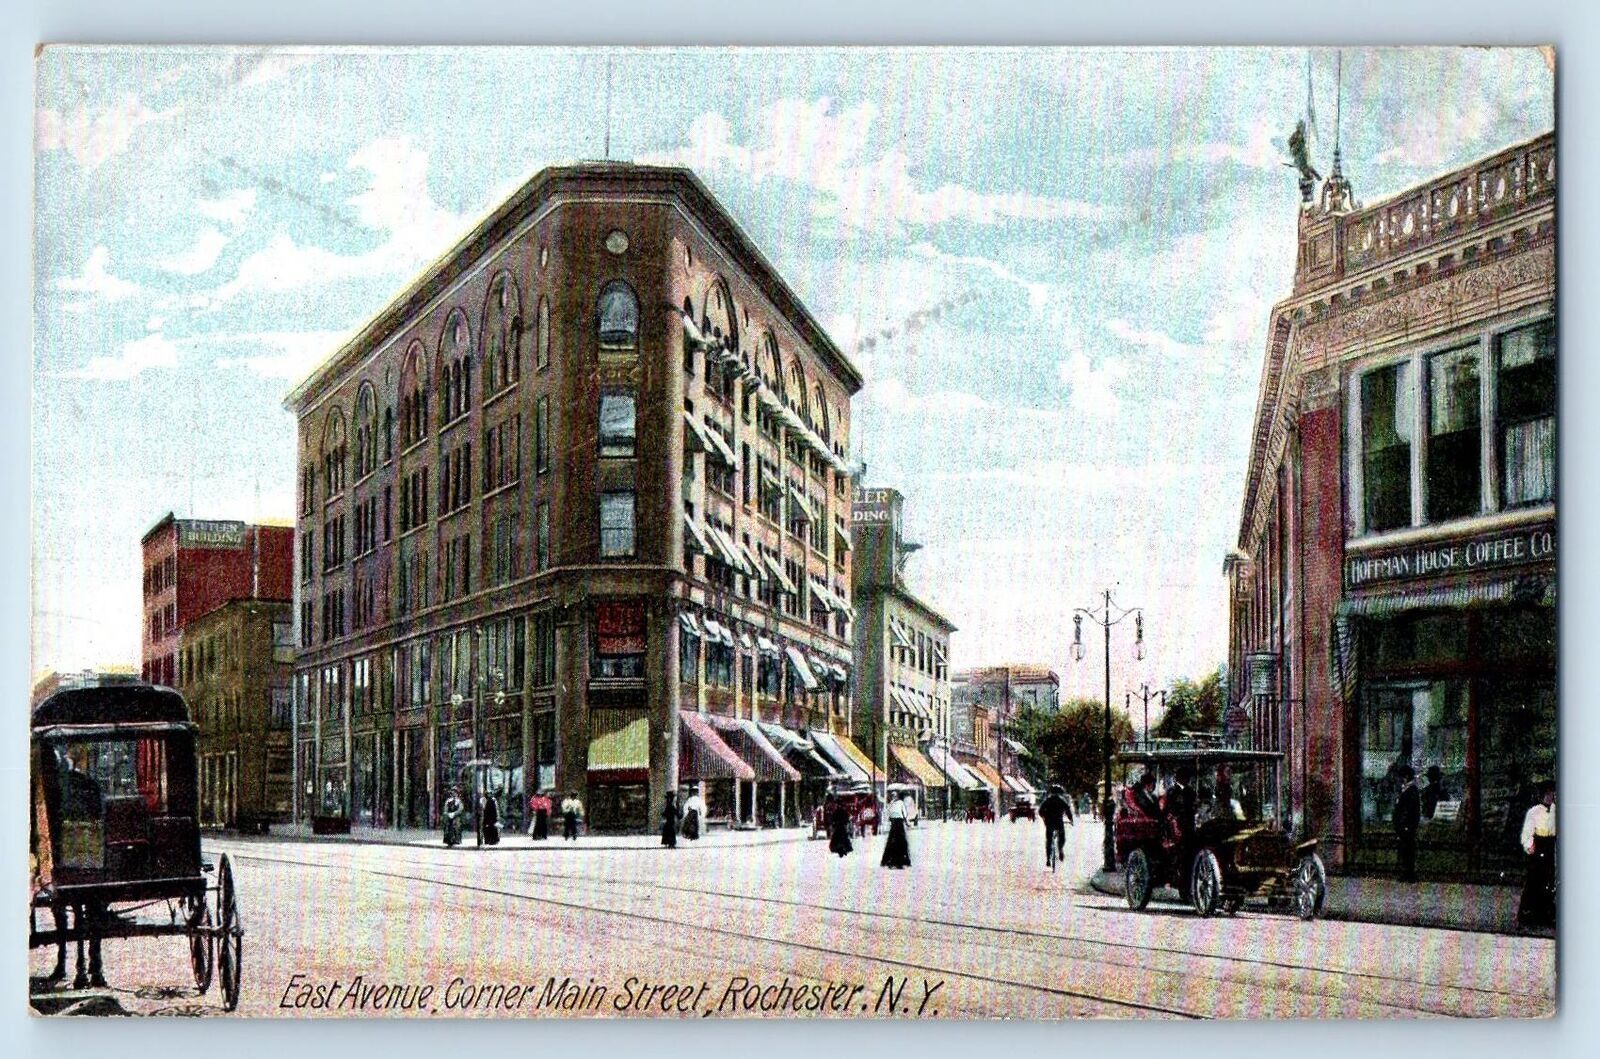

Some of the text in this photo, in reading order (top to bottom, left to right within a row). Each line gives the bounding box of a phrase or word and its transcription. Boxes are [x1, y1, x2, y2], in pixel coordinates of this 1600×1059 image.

[1351, 554, 1409, 584] HOFFMAN
[1416, 546, 1460, 575] HOUSE
[1465, 537, 1524, 567] COFFEE
